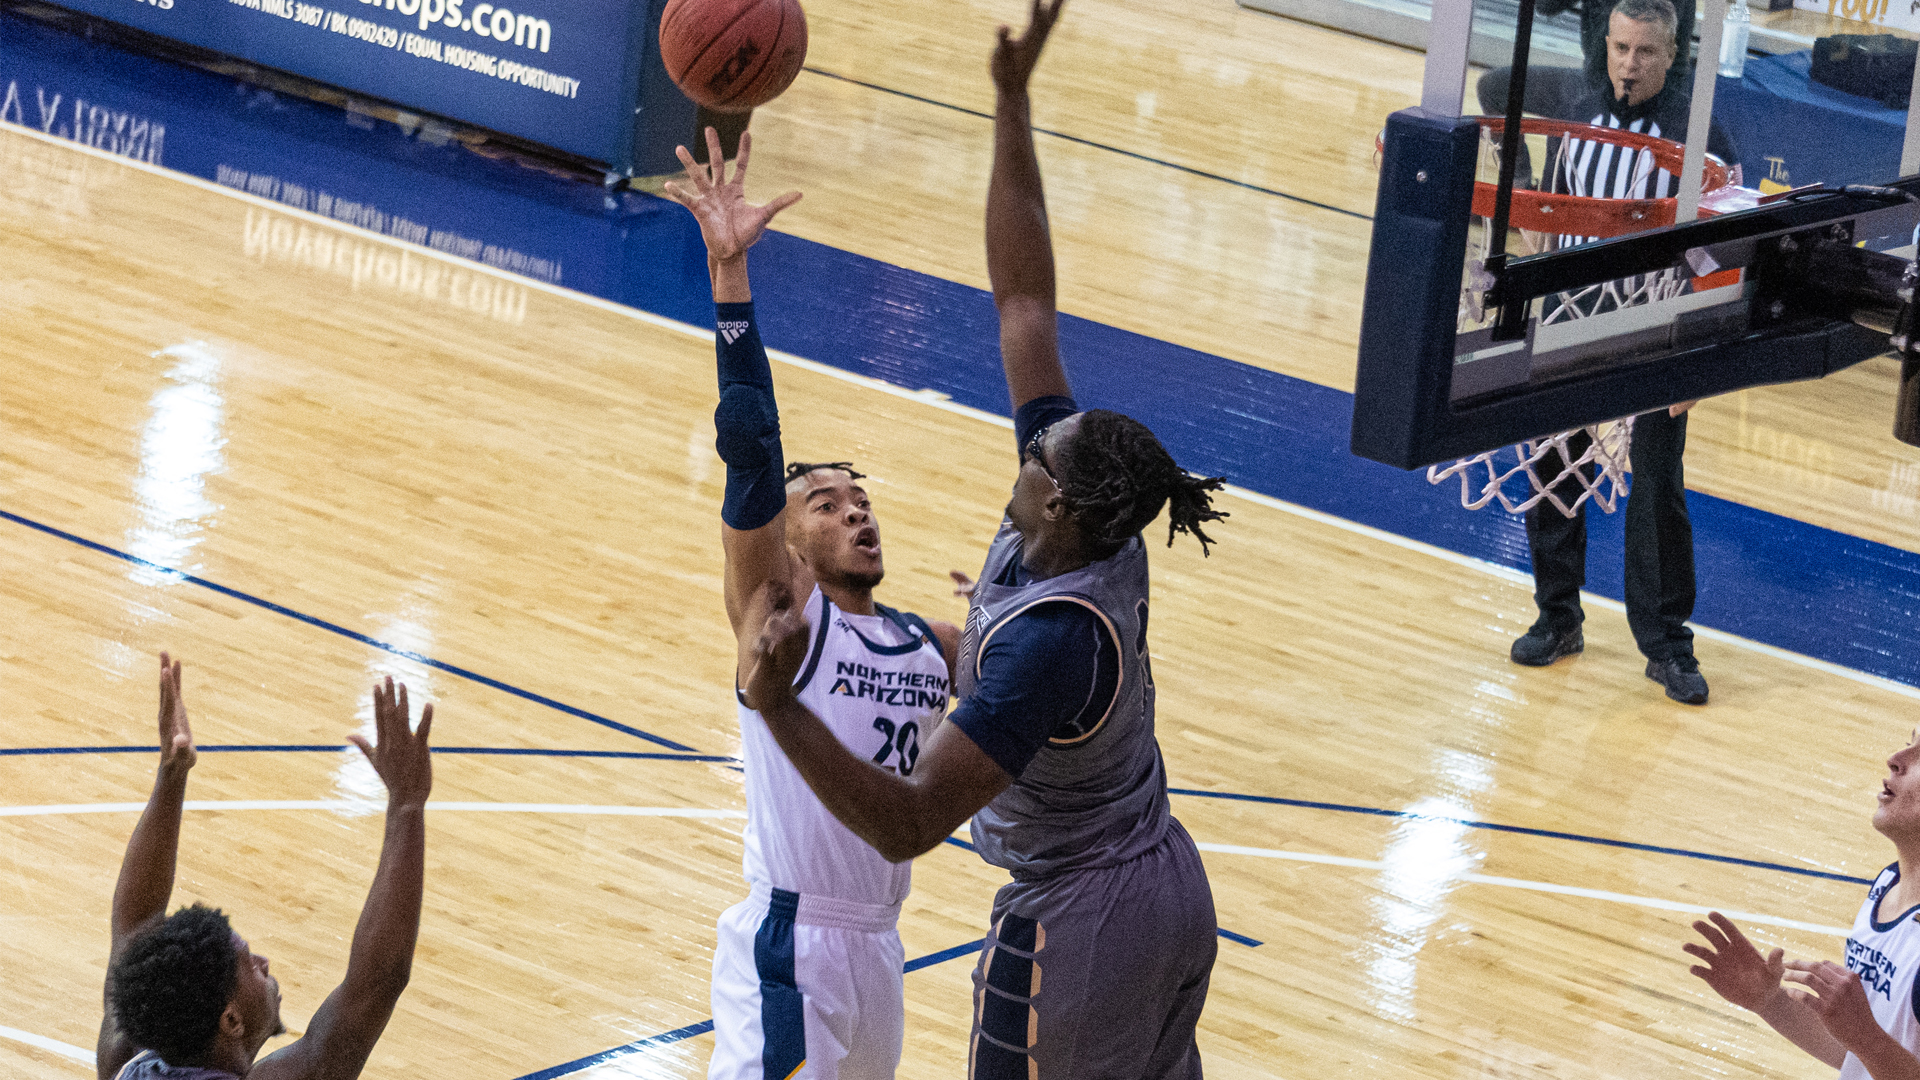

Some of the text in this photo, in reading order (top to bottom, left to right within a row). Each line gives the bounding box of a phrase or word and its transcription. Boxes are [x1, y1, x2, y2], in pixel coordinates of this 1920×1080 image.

[293, 2, 324, 27] 3087
[331, 11, 349, 35] BK
[347, 17, 398, 48] 0902429
[405, 32, 443, 62] EQUAL
[443, 44, 498, 77] HOUSING
[497, 58, 581, 99] OPPORTUNITY
[829, 678, 946, 713] ARIZONA
[837, 660, 949, 692] NORTHERN
[872, 716, 919, 776] 20
